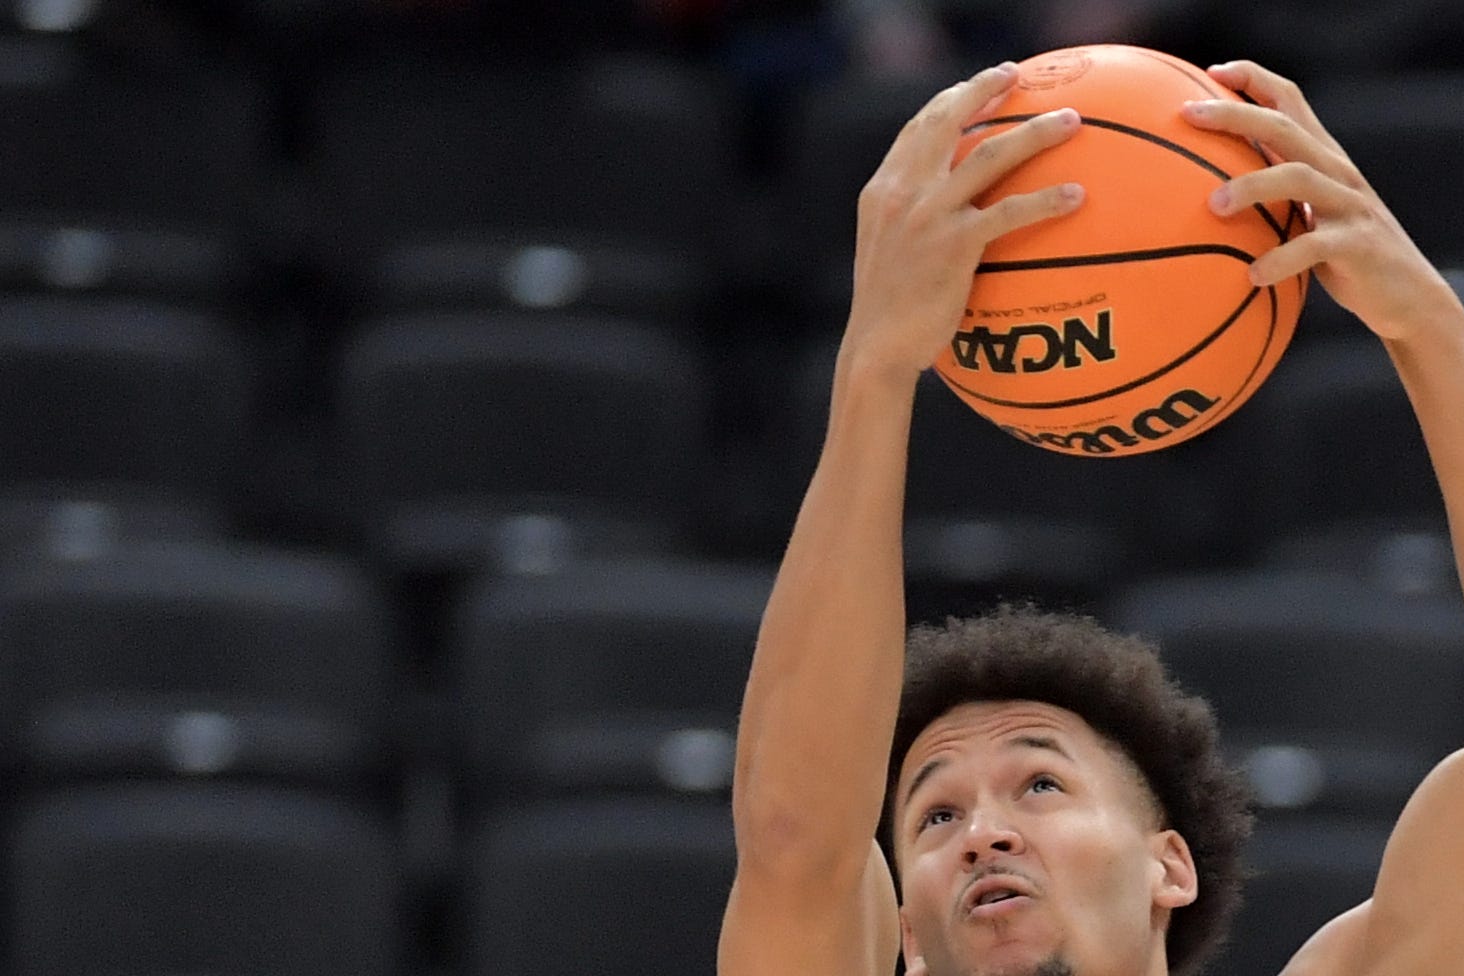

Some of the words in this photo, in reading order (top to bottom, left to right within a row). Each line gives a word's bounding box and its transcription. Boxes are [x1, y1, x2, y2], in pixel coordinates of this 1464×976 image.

[977, 307, 1025, 318] GAME
[1028, 292, 1107, 316] OFFICIAL
[951, 309, 1116, 374] NCAA
